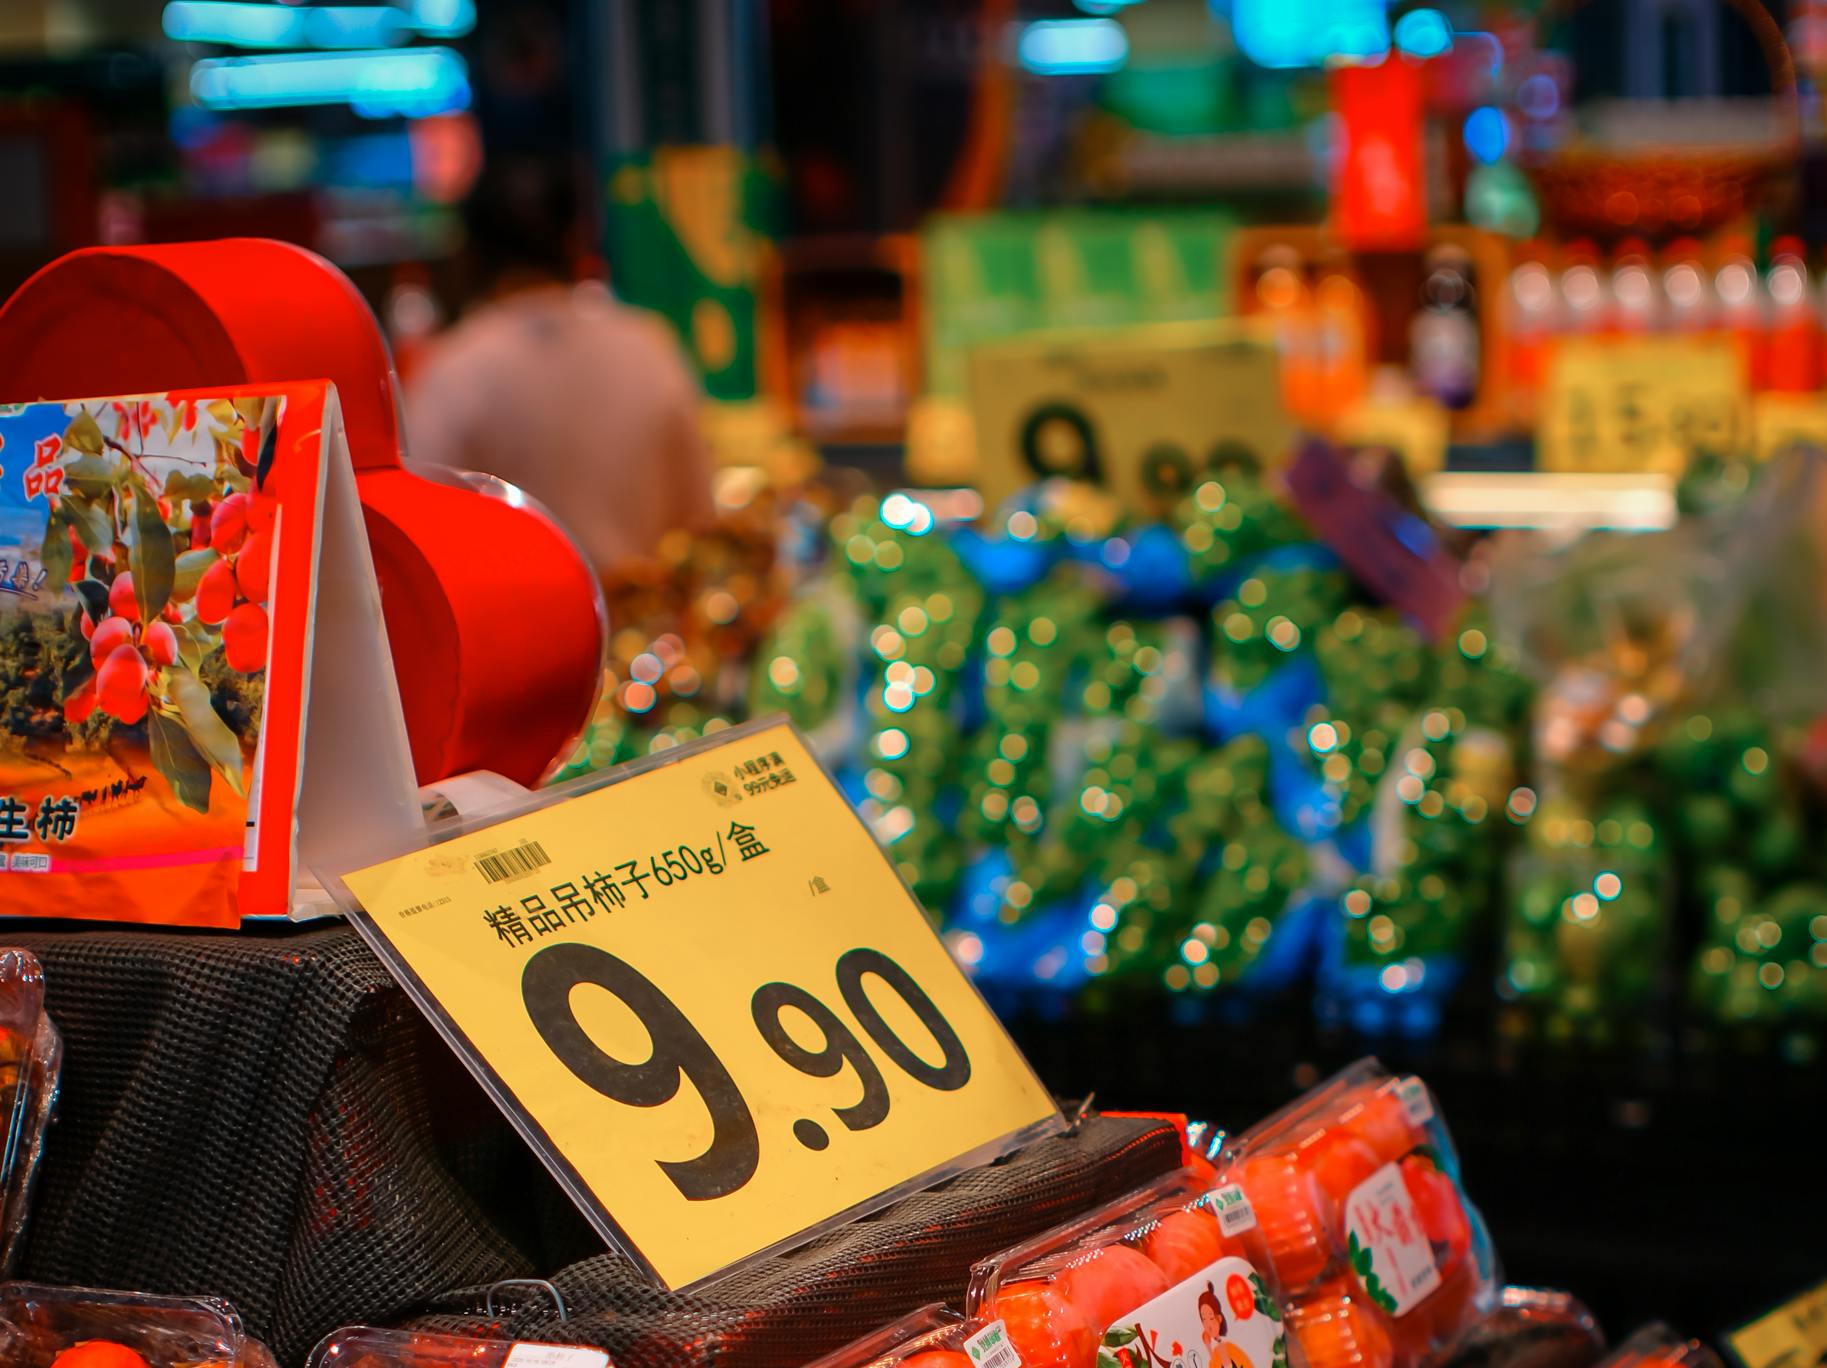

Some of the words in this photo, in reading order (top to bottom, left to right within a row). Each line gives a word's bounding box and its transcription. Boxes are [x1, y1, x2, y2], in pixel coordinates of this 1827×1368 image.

[483, 821, 770, 948] 精品吊柿子650g/盒
[521, 943, 972, 1201] 9.90
